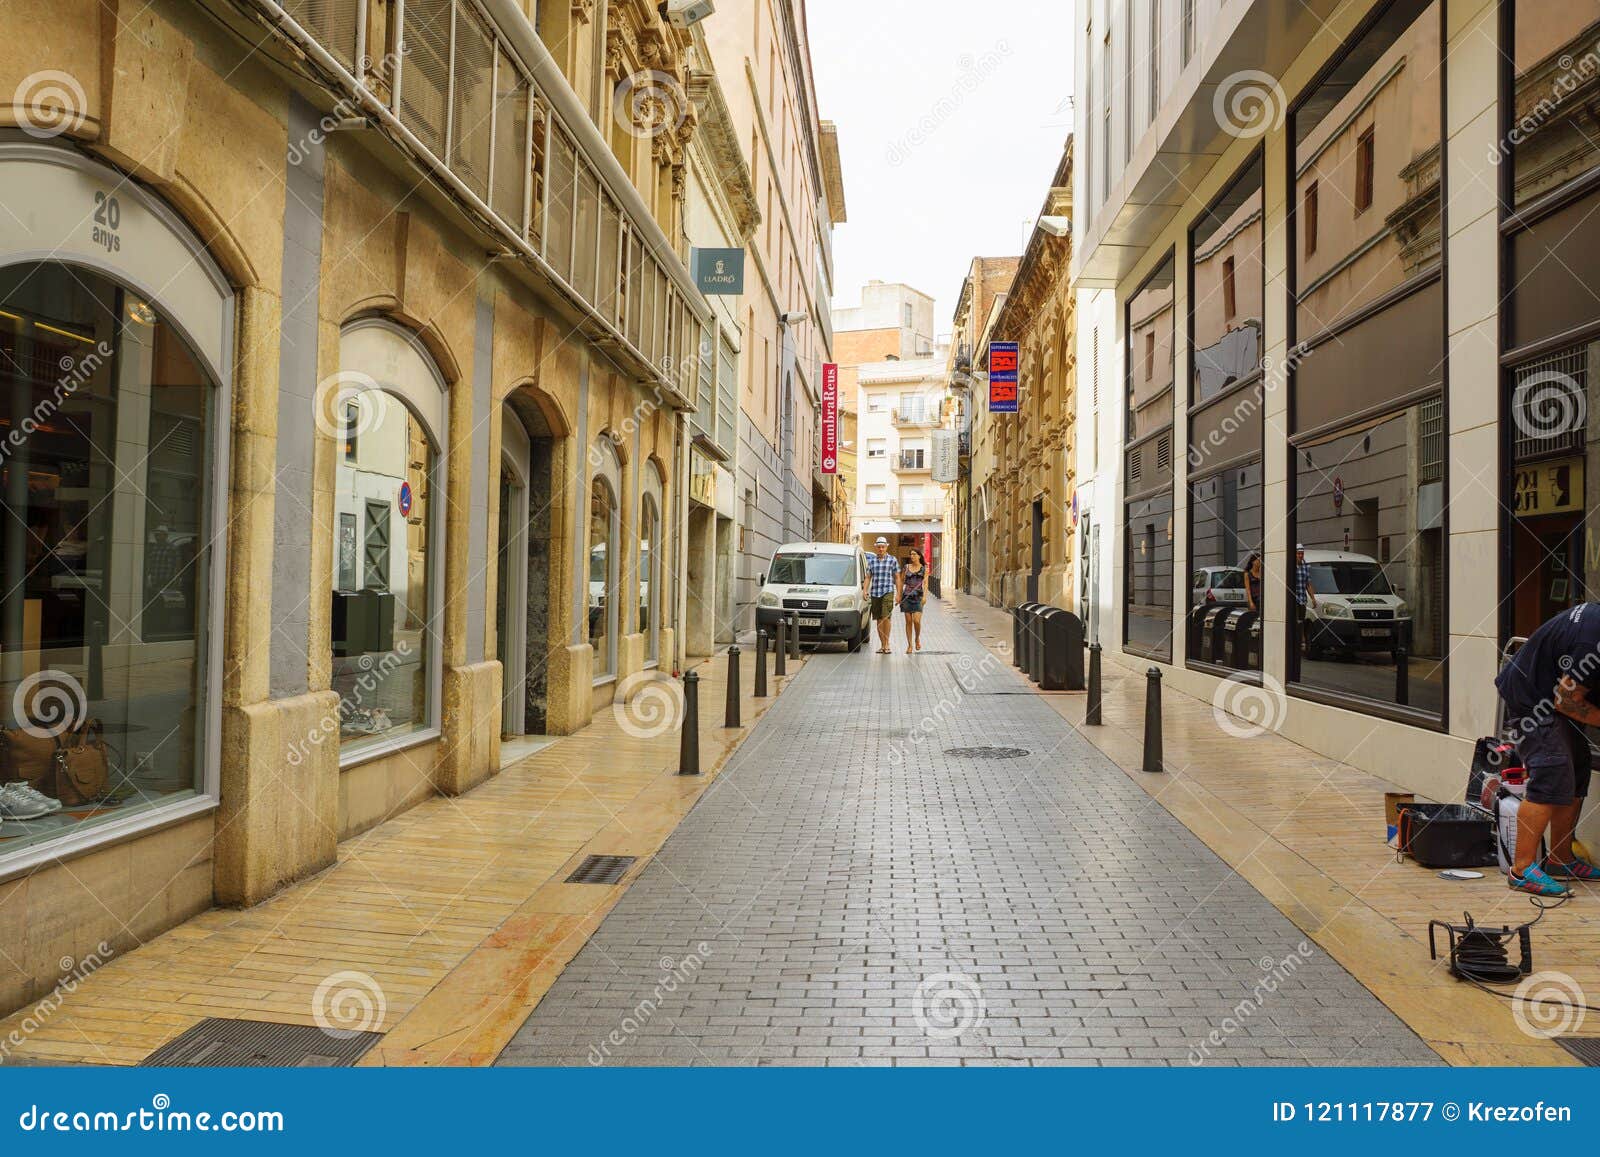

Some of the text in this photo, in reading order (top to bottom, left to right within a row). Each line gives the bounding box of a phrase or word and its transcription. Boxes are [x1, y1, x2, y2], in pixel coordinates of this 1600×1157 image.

[94, 190, 120, 230] 20
[93, 226, 120, 253] anys
[823, 368, 835, 451] cambraReus
